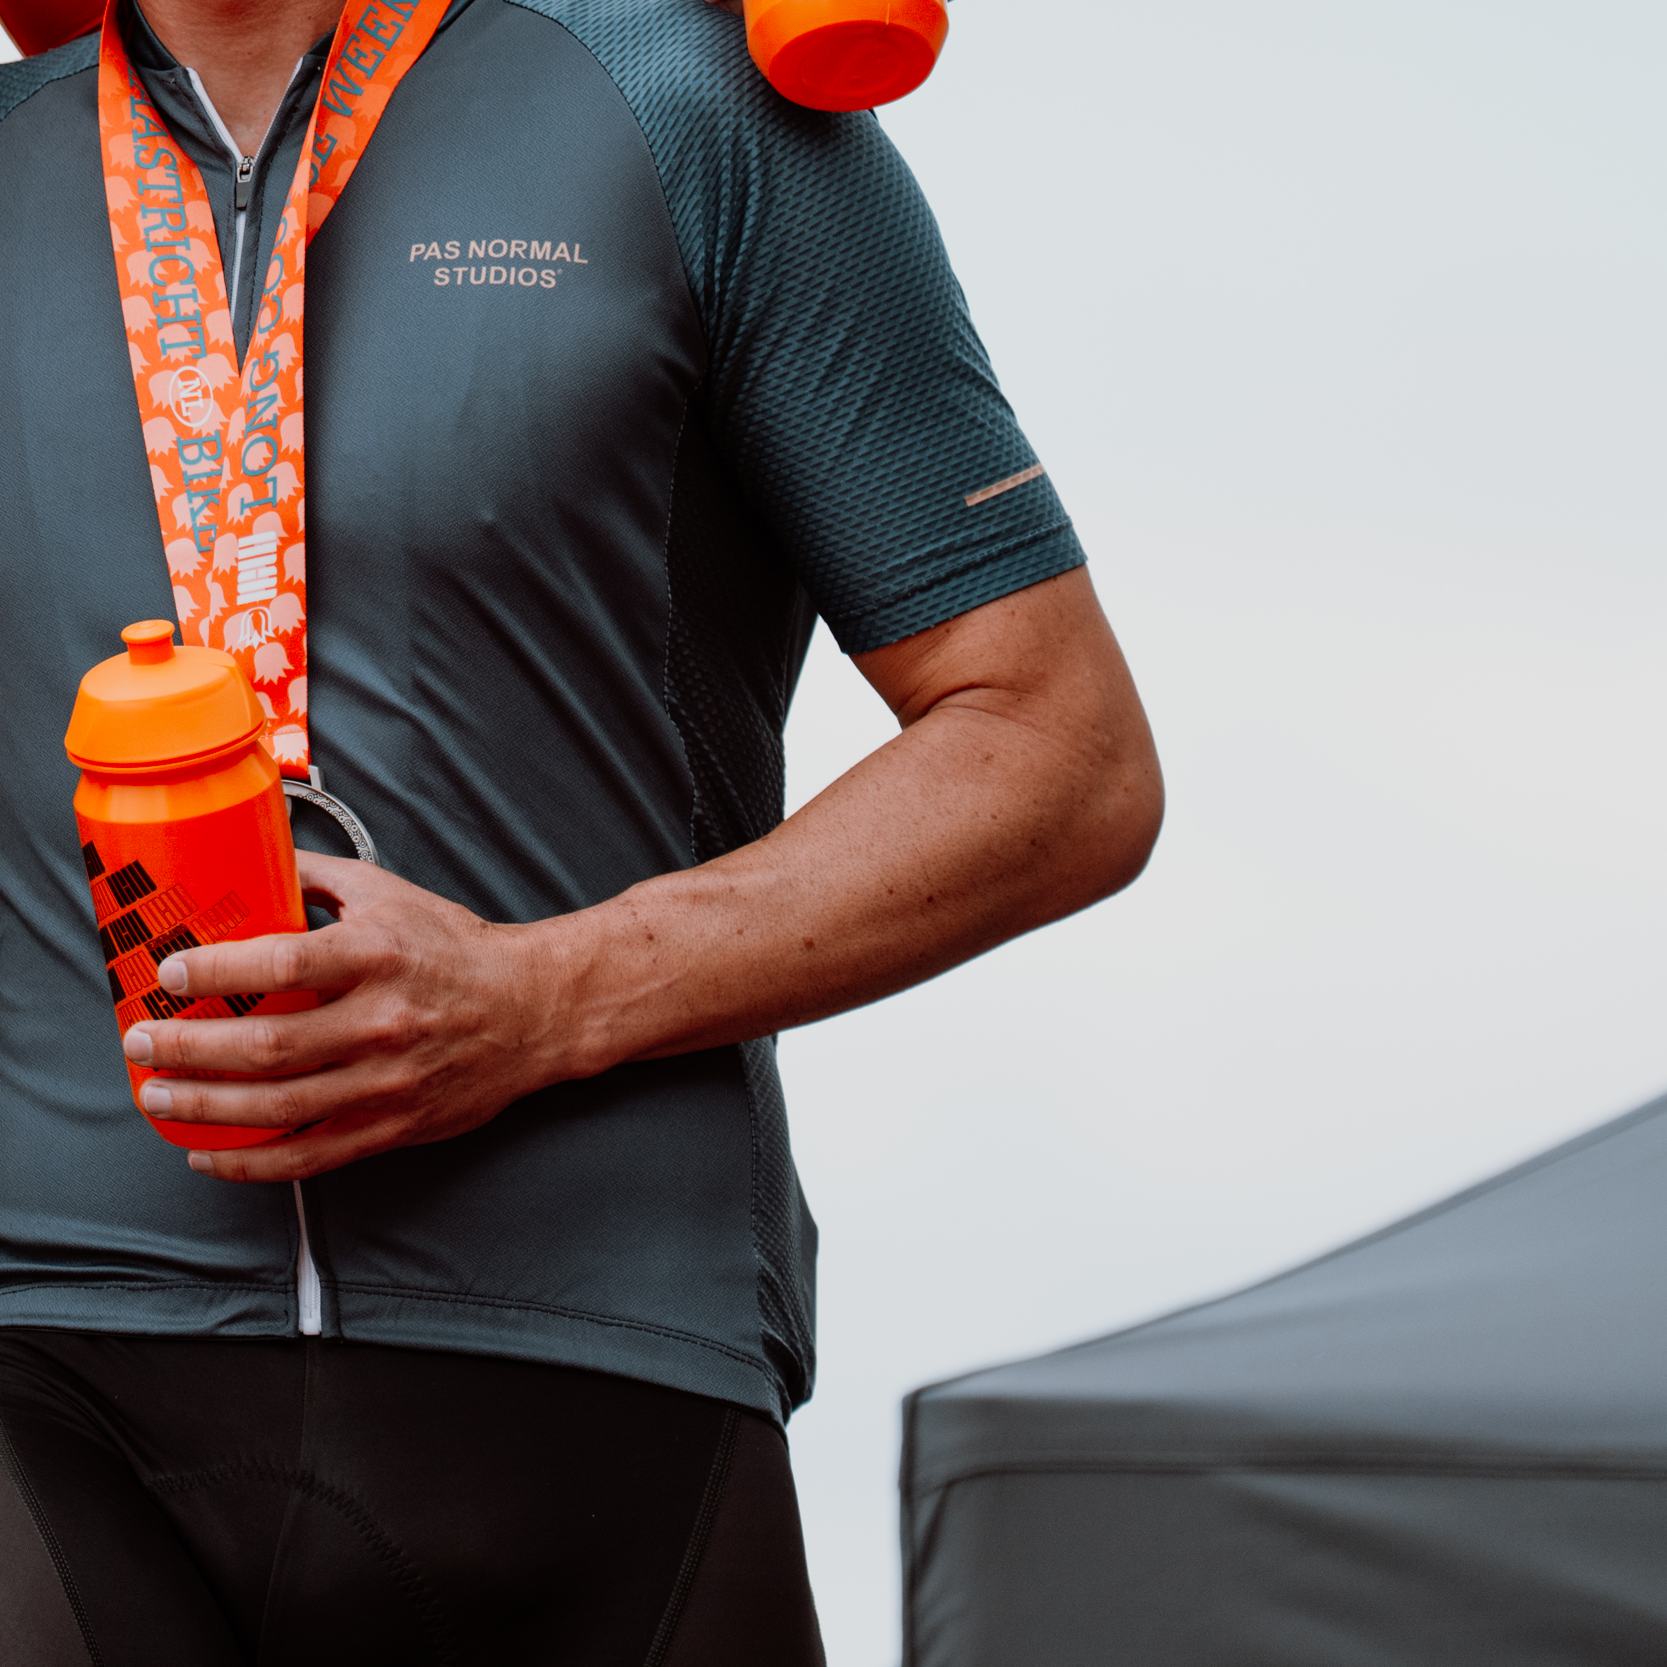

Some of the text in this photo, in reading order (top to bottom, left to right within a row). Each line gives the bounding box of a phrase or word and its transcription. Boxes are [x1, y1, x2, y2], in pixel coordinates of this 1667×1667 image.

[409, 238, 589, 264] PAS NORMAL
[433, 265, 557, 289] STUDIOS
[126, 58, 224, 553] AASTRICHT NL BIKE
[239, 349, 280, 516] LONG
